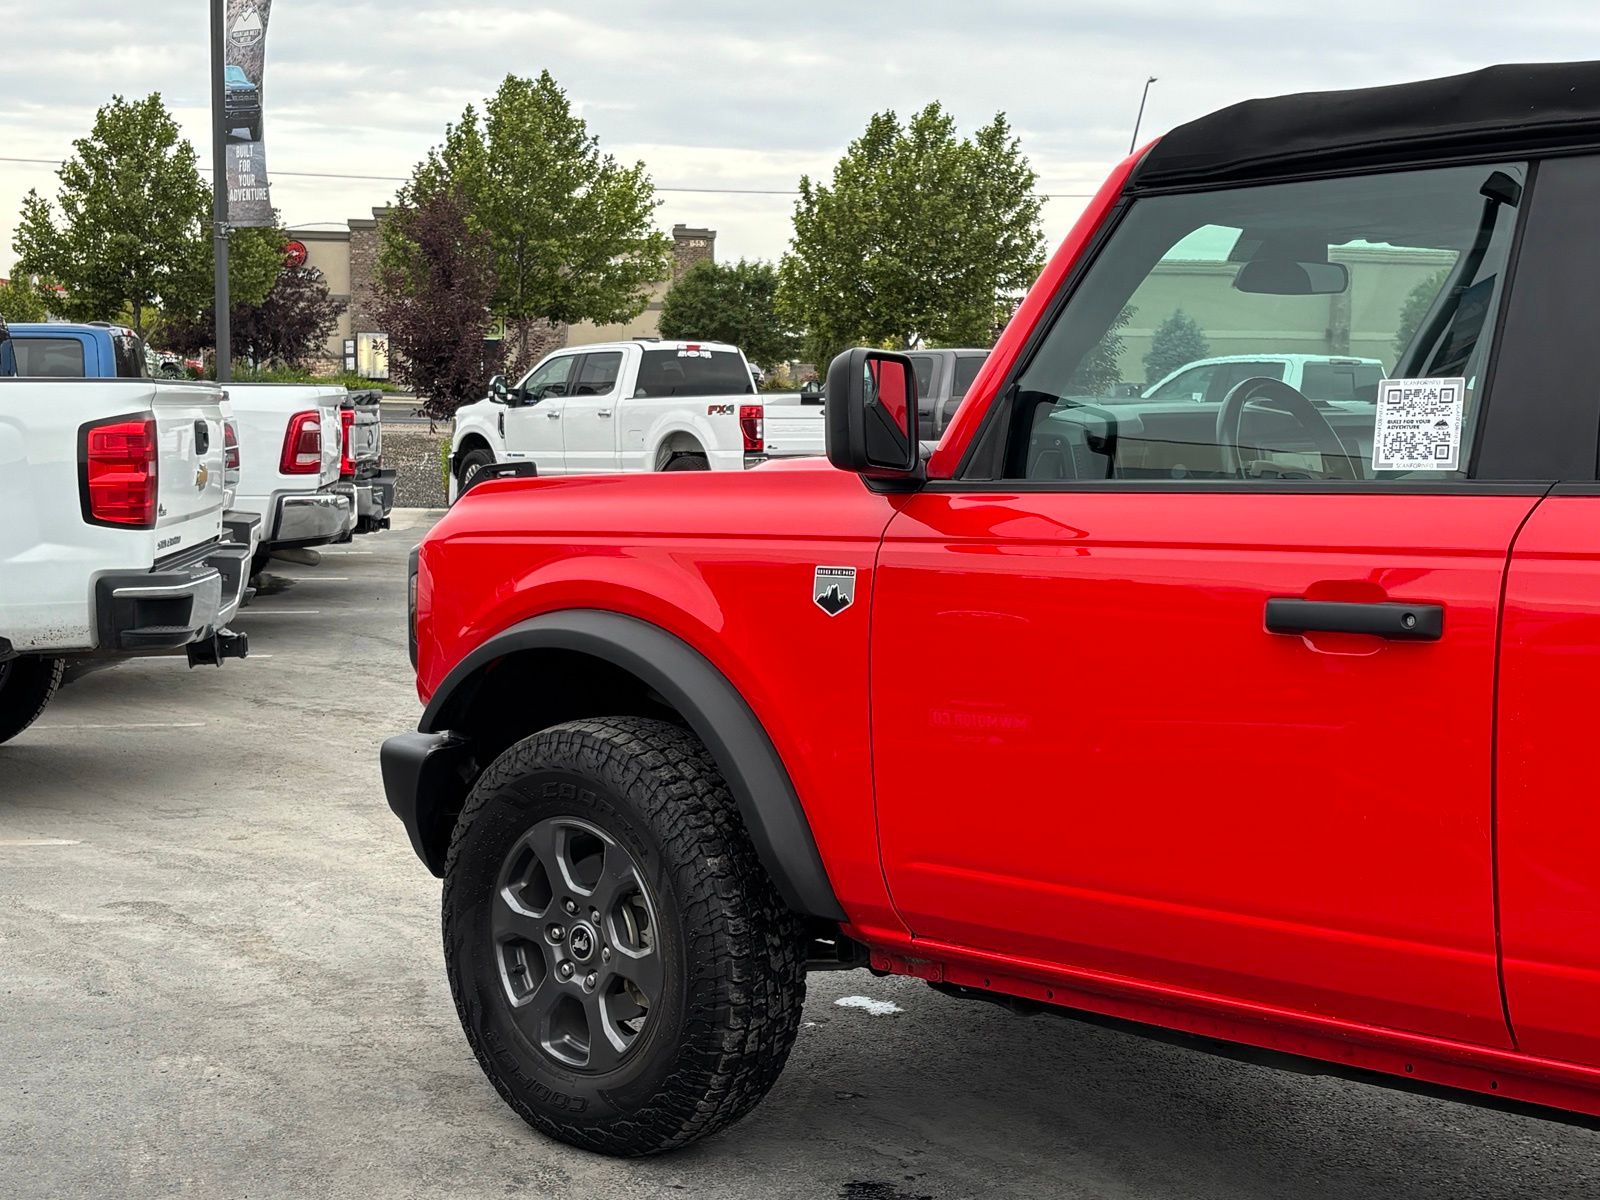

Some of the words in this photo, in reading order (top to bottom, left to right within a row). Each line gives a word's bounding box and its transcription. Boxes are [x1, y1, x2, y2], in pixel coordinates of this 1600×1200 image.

[236, 145, 253, 157] BUILT
[239, 160, 251, 172] FOR
[239, 175, 256, 186] YOUR
[229, 188, 268, 201] ADVENTURE
[708, 405, 735, 416] FX4
